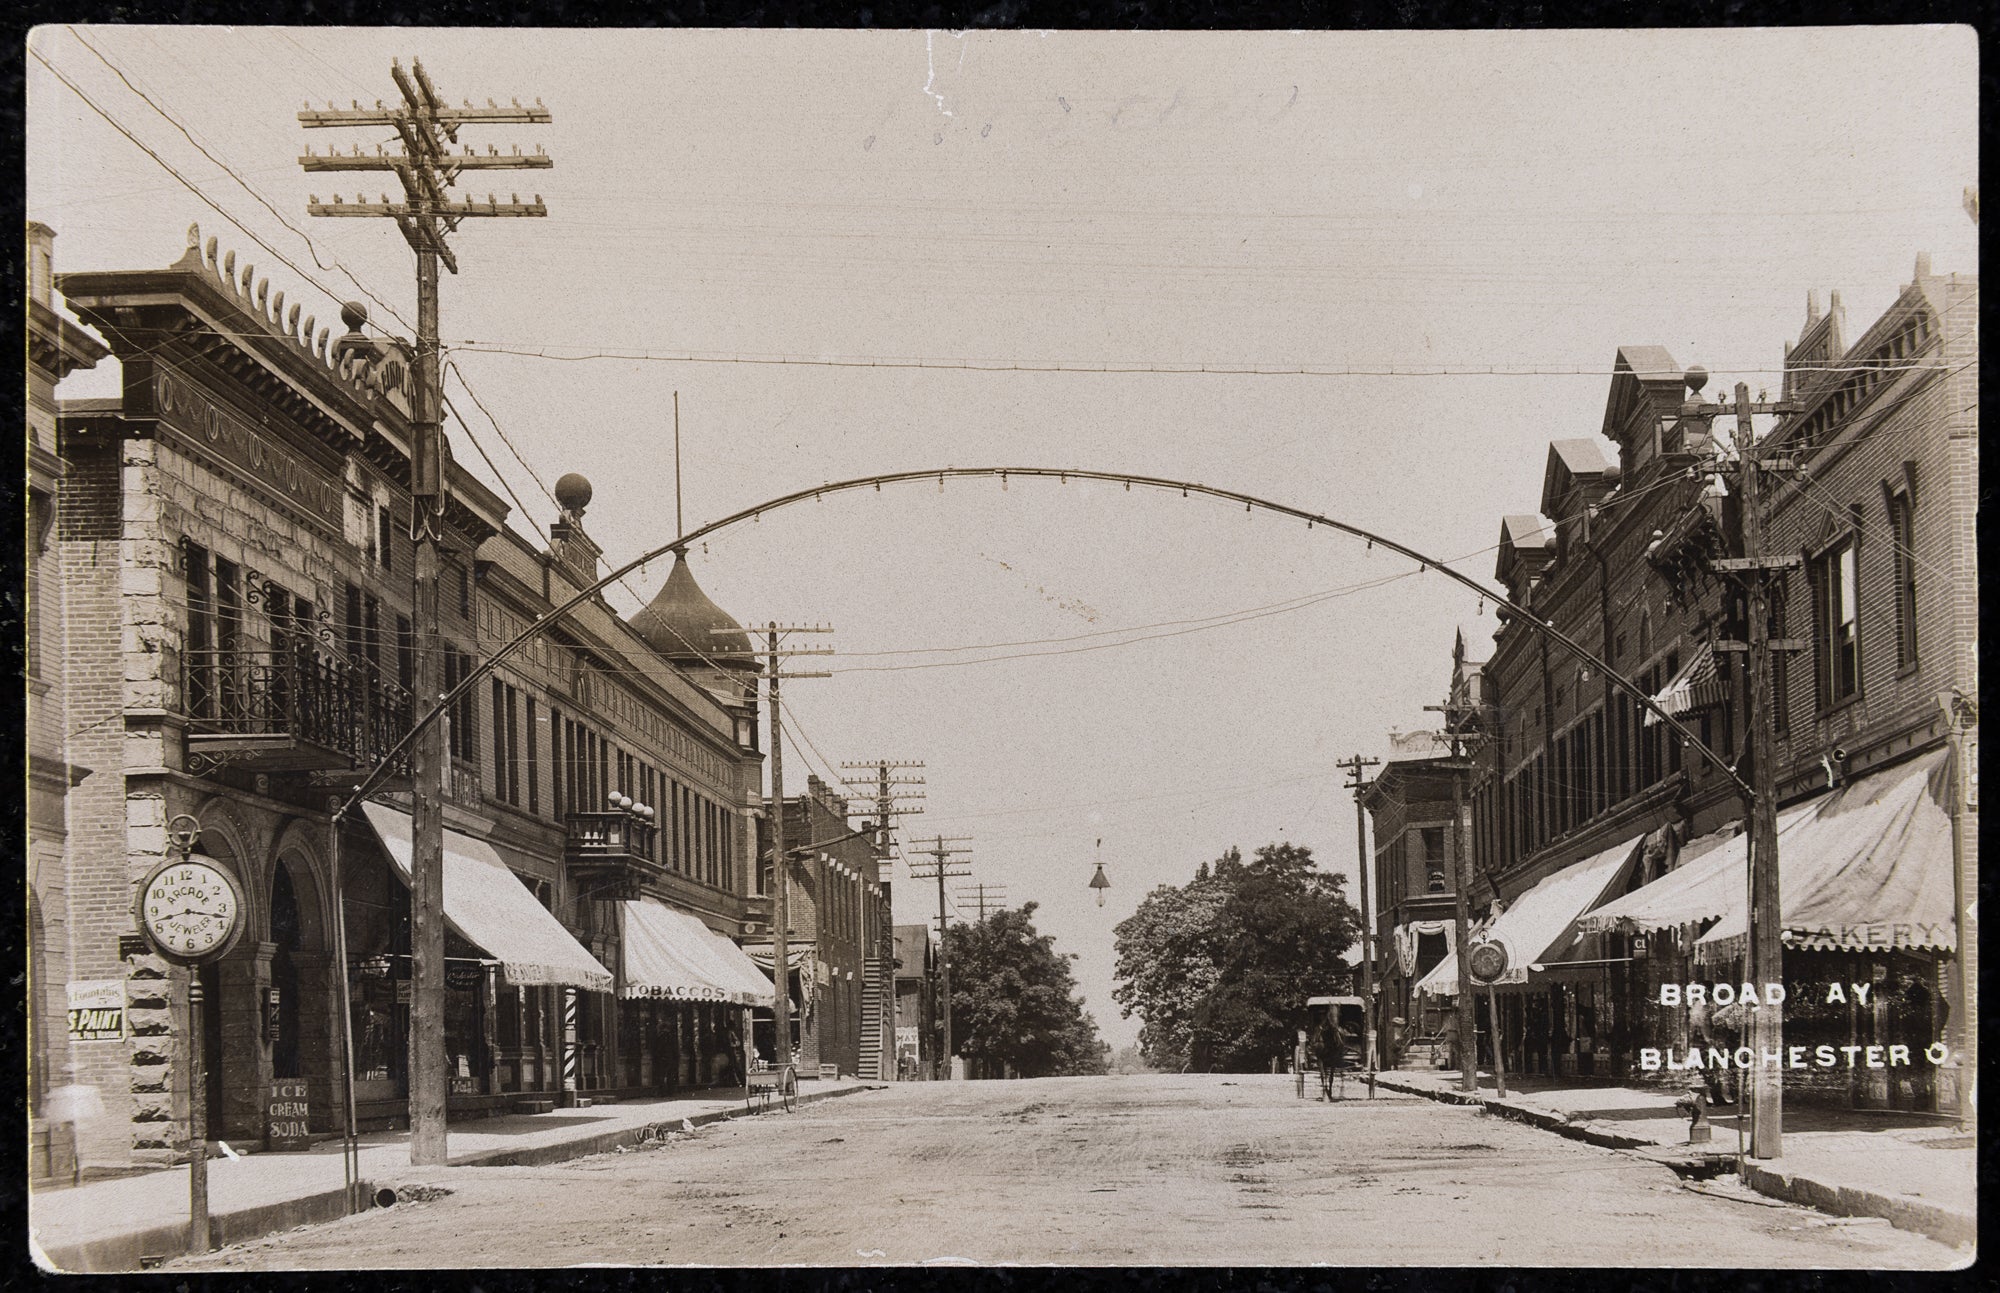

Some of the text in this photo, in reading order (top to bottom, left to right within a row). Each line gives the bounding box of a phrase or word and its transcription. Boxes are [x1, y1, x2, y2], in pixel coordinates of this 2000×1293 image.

[164, 876, 174, 886] 11
[180, 870, 193, 881] 12
[202, 874, 207, 884] 1
[152, 888, 165, 899] 10
[167, 886, 210, 905] ARCADE
[212, 885, 221, 896] 2
[150, 906, 159, 917] 9
[218, 903, 227, 913] 3
[155, 923, 164, 934] 8
[169, 916, 211, 935] JEWELER
[215, 920, 225, 930] 4
[204, 933, 213, 944] 5
[1787, 922, 1939, 945] BAKERY
[168, 935, 176, 945] 7
[185, 938, 195, 949] 6
[626, 985, 725, 999] TOBACCOS
[78, 1009, 121, 1031] PAINT
[271, 1085, 307, 1097] ICE
[270, 1103, 308, 1117] CREAM
[270, 1122, 308, 1137] SODA
